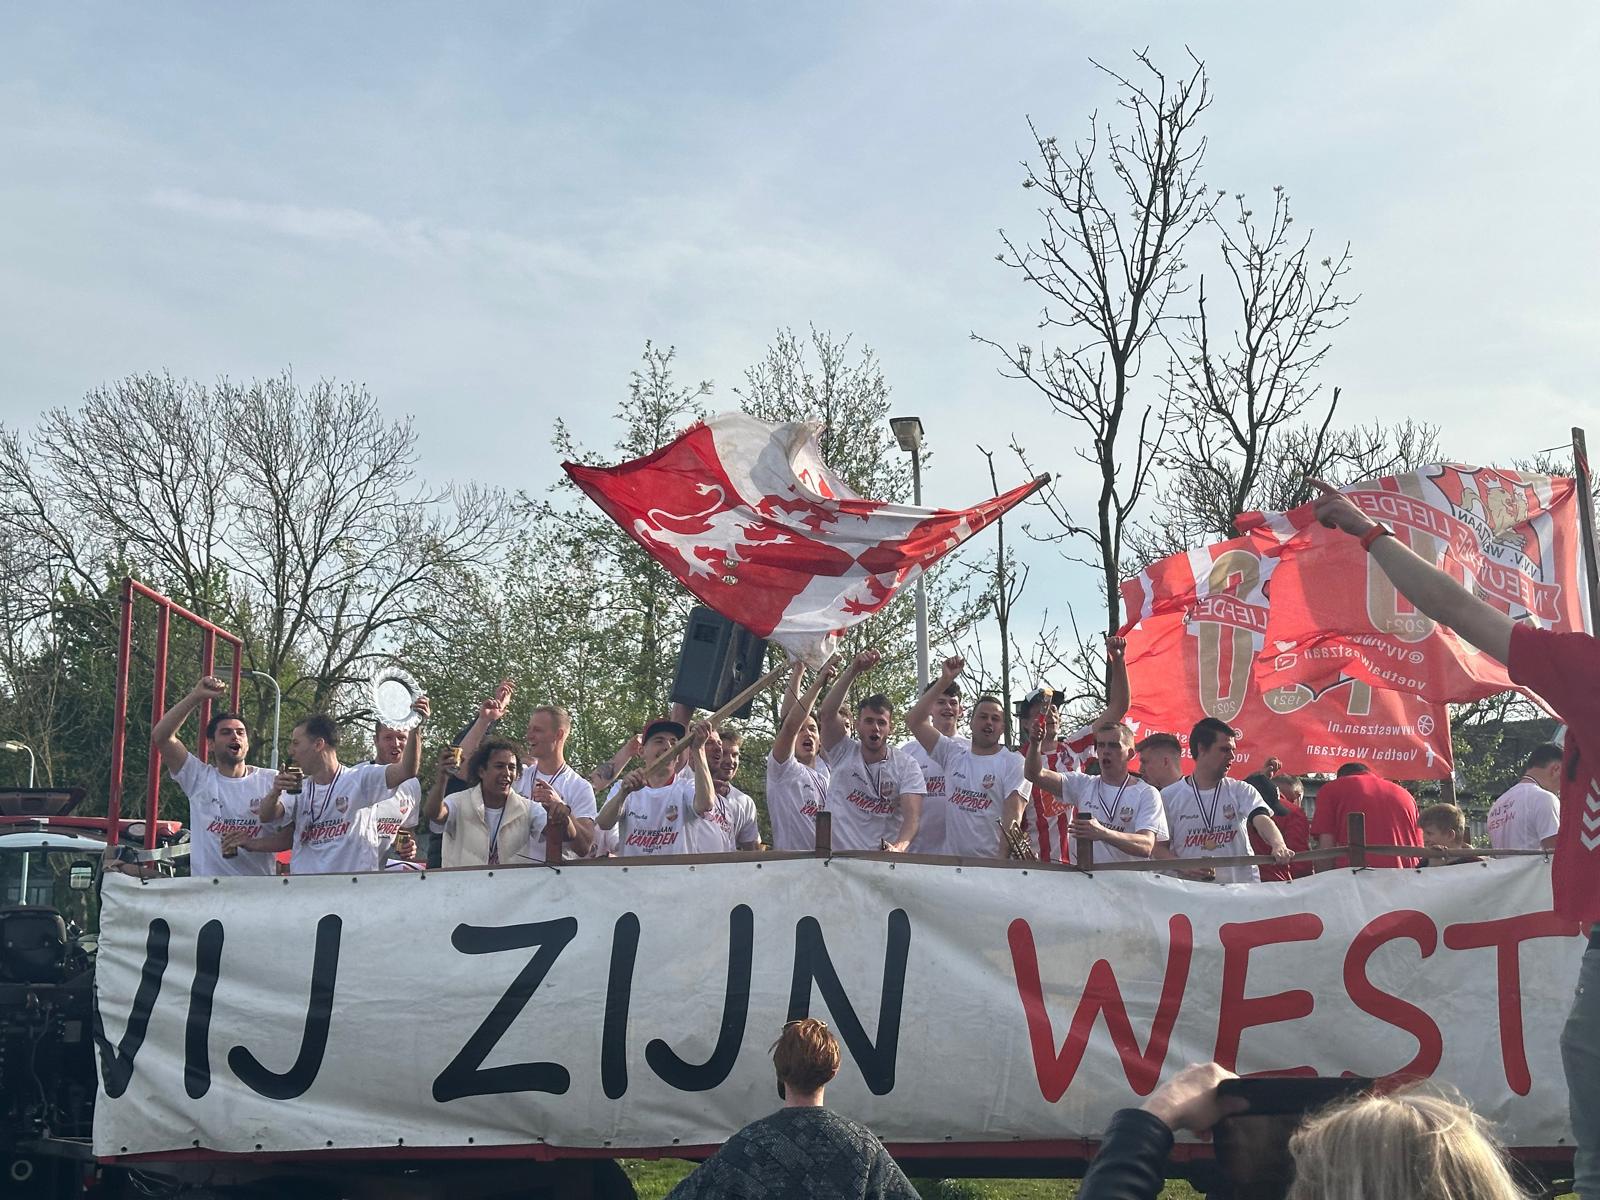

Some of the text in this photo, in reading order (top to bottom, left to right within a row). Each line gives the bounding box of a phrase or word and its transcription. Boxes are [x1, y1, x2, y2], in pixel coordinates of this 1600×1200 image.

[625, 831, 679, 848] KAMPOEN
[433, 904, 911, 1103] ZIJN
[1008, 908, 1584, 1103] WEST
